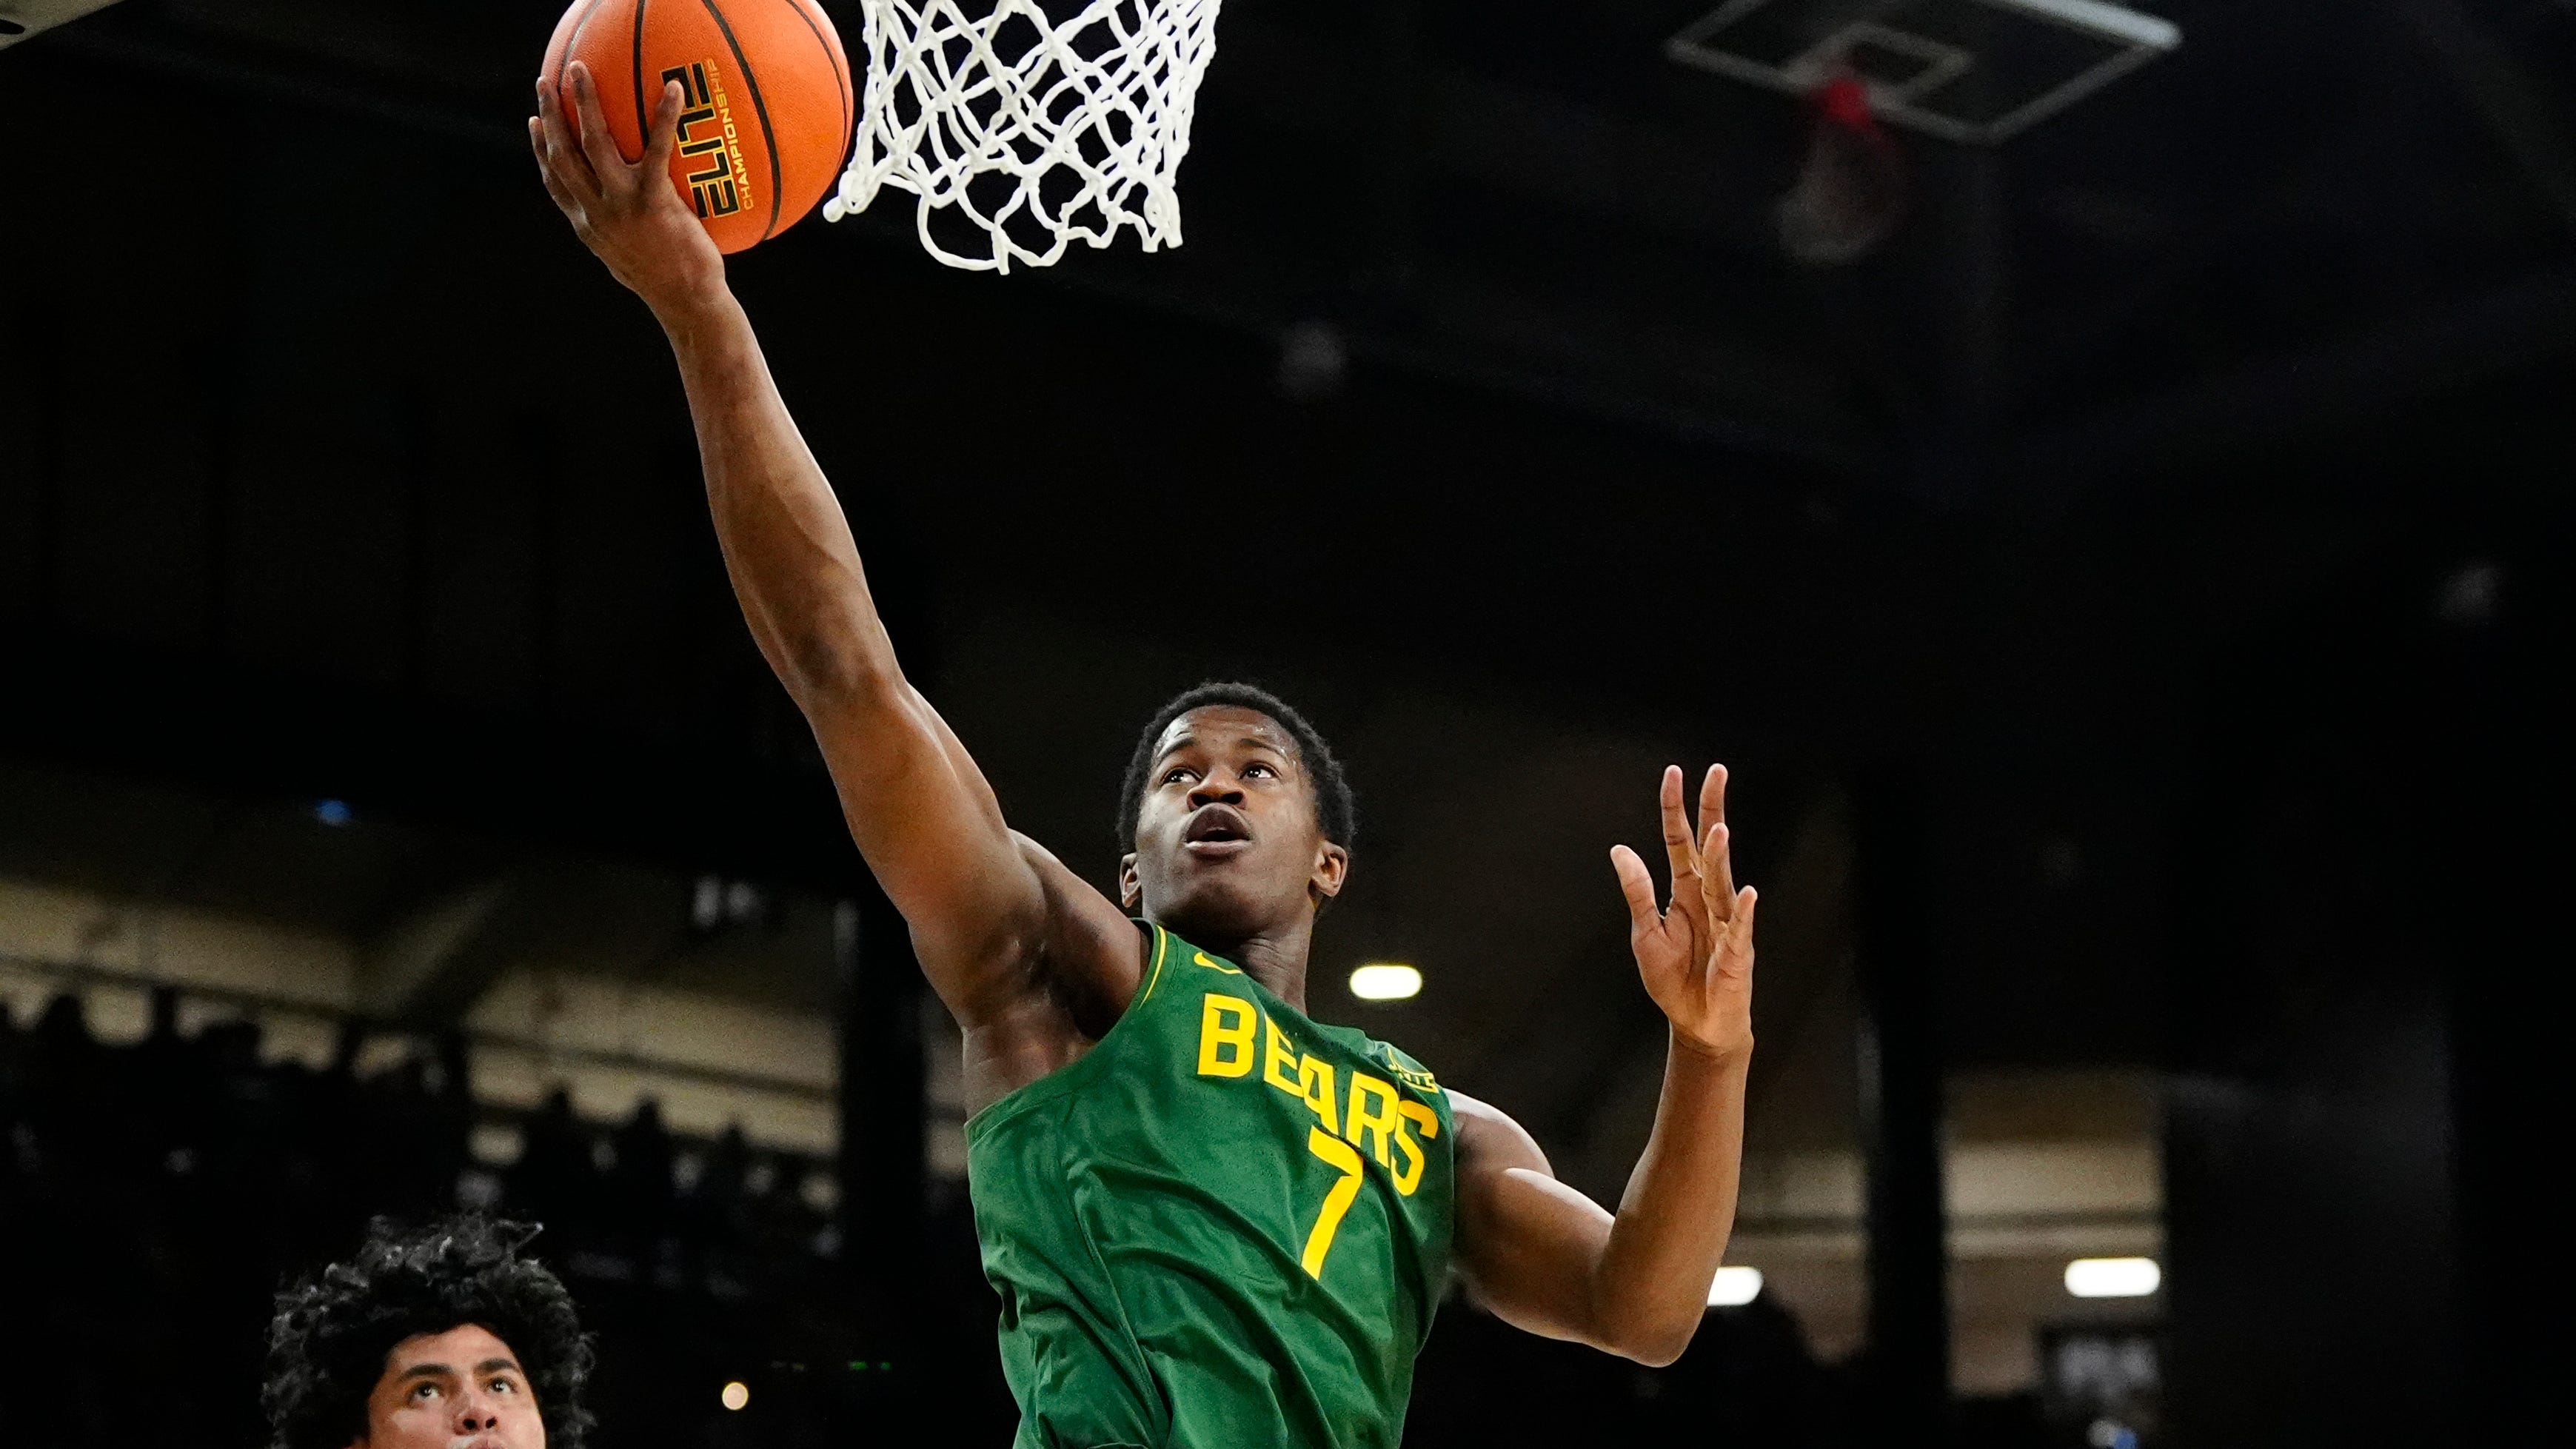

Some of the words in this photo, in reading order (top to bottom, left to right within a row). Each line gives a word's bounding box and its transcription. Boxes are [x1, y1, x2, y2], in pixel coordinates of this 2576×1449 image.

[660, 61, 740, 218] ELITE
[707, 58, 754, 210] CHAMPIONSHIP
[1197, 993, 1439, 1197] BEARS
[1301, 1125, 1364, 1282] 7
